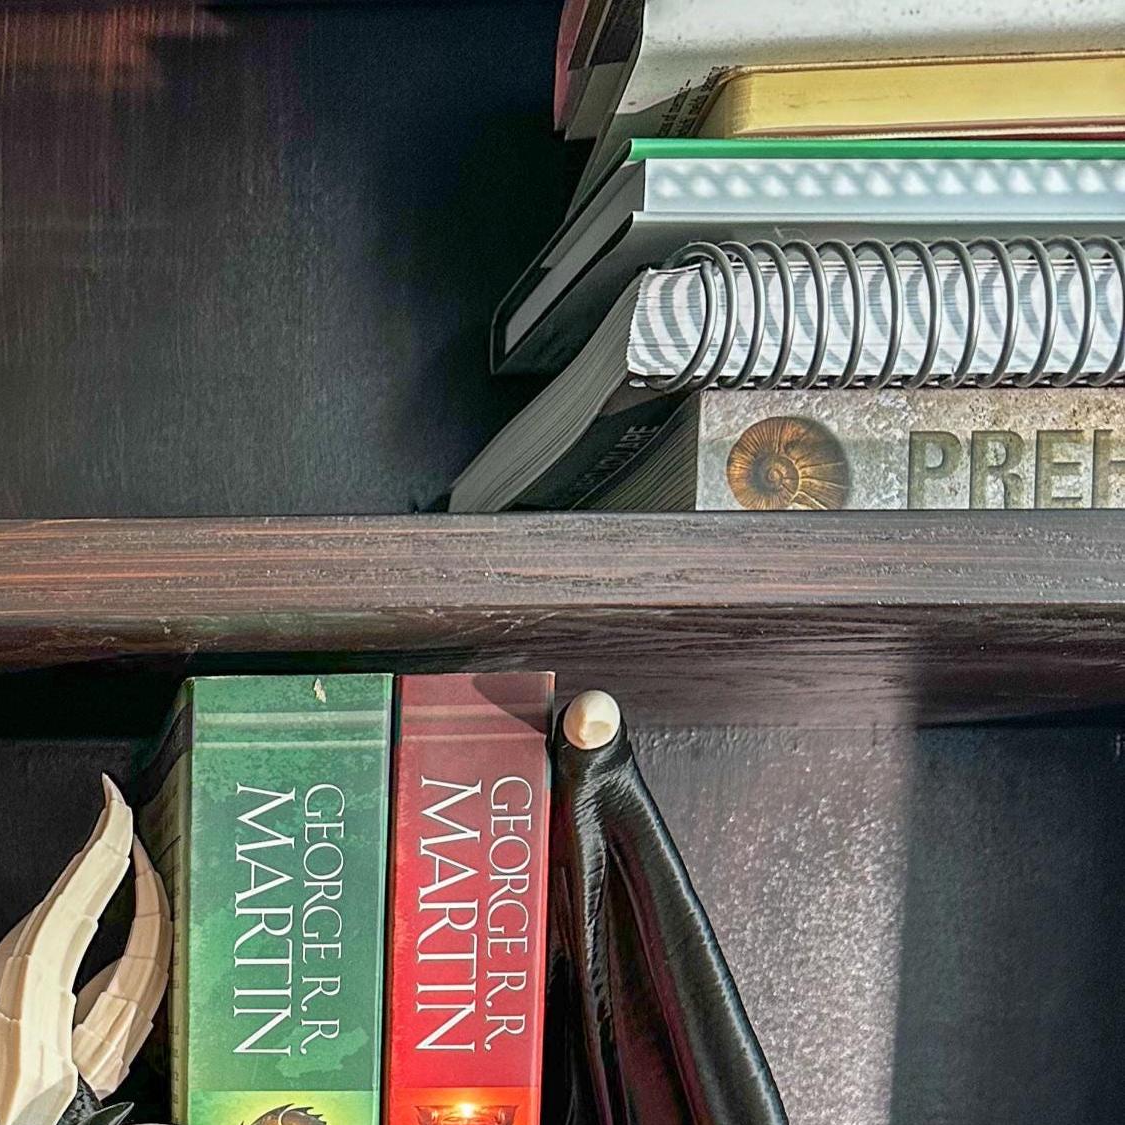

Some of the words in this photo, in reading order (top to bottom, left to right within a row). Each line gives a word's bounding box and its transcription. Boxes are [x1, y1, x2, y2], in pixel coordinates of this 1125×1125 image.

[232, 782, 296, 1056] MARTIN
[301, 783, 346, 965] GEORGE
[415, 775, 482, 1053] MARTIN
[486, 776, 533, 959] GEORGE
